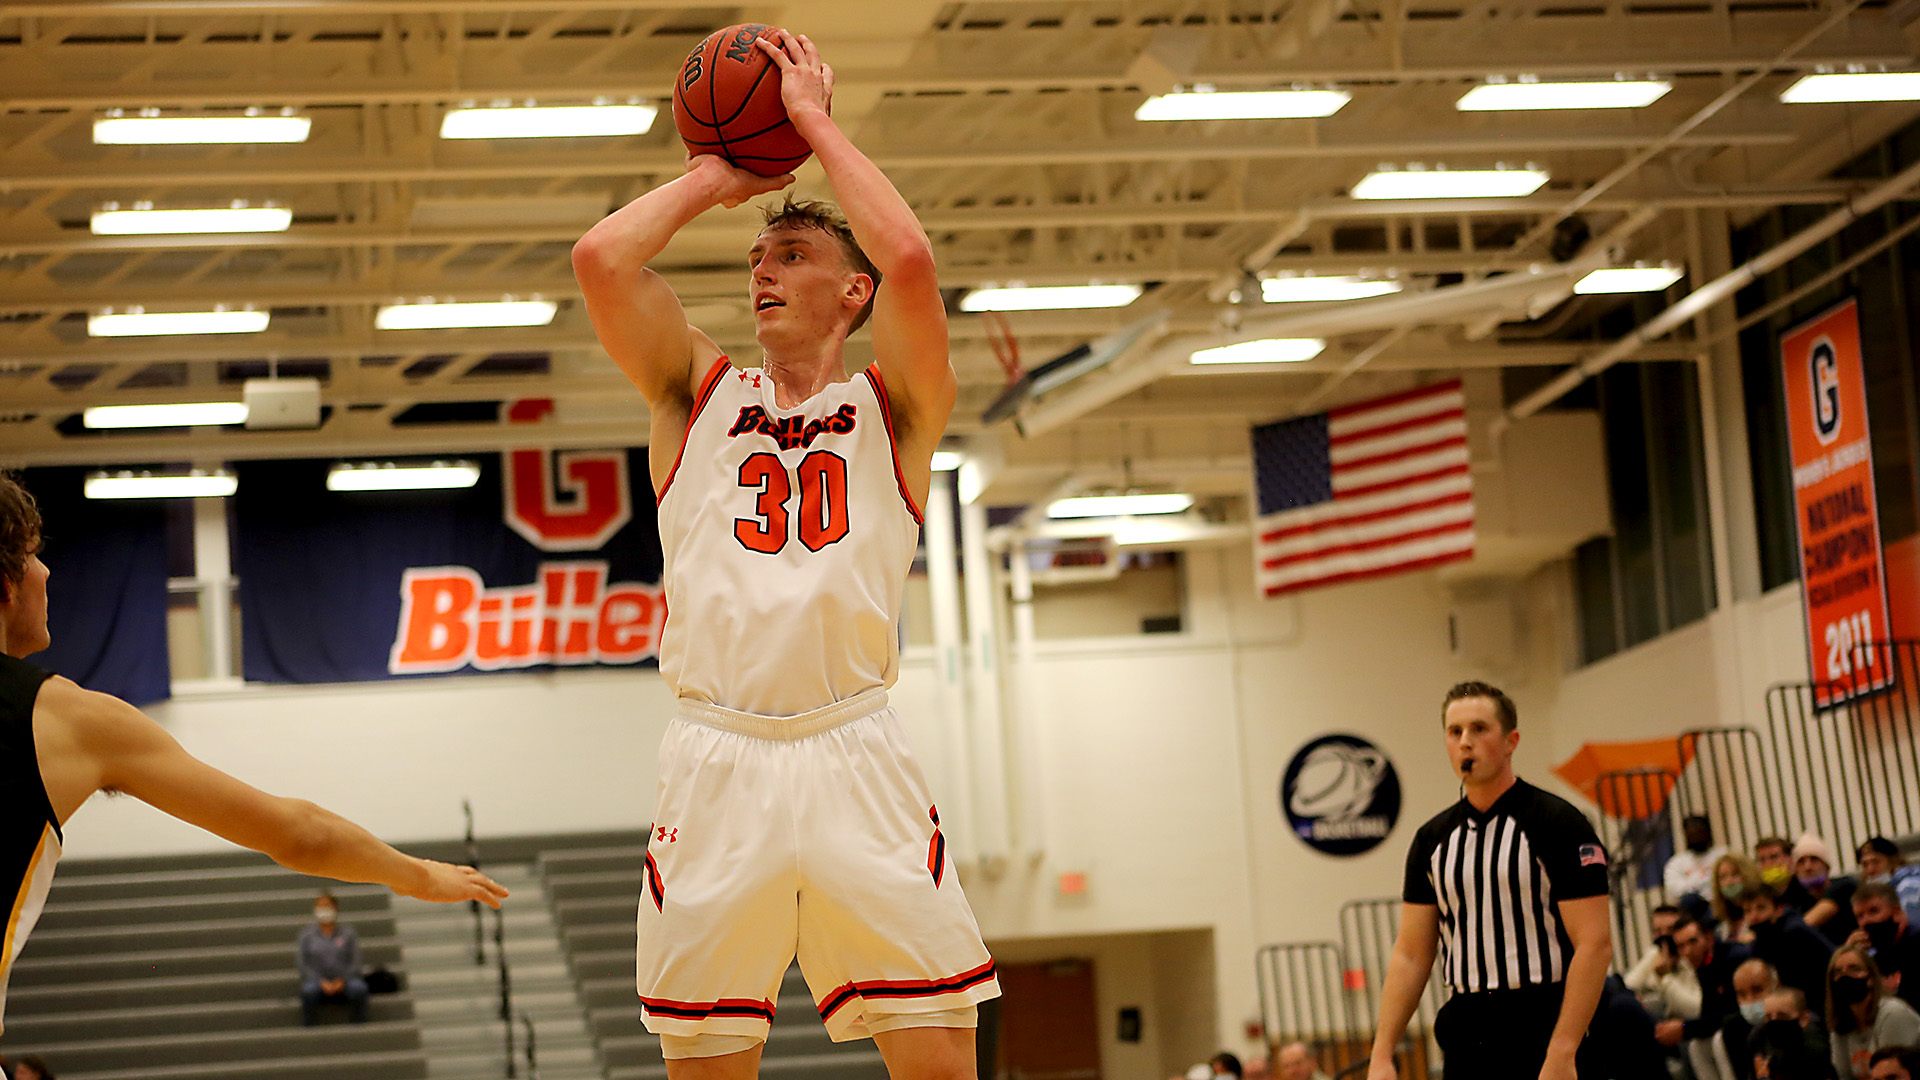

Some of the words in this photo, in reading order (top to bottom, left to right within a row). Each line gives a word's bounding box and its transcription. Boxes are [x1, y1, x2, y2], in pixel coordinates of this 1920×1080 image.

[1808, 334, 1842, 446] G
[501, 397, 632, 551] G
[733, 449, 850, 555] 30
[389, 561, 668, 674] Bulle
[1825, 609, 1874, 680] 2011
